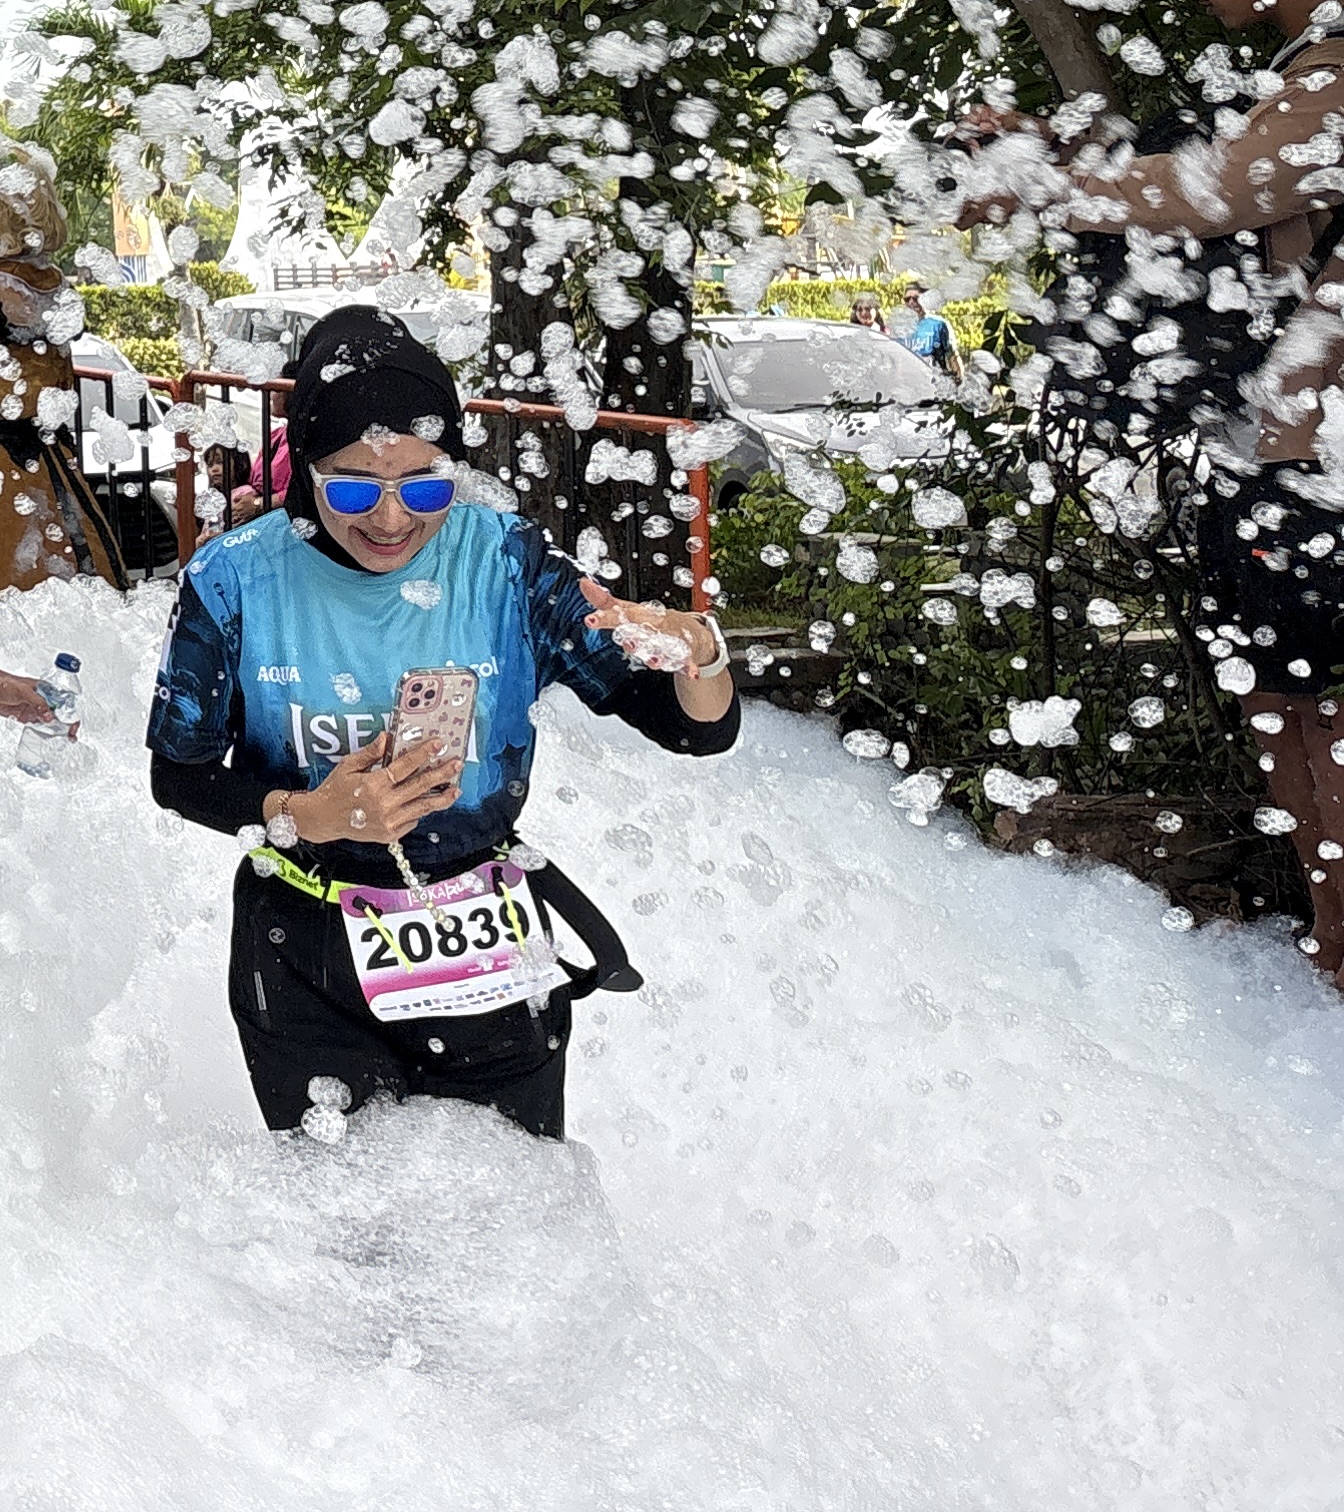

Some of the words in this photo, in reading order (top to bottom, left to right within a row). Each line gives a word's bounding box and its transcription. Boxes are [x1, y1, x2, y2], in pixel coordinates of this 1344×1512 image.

[256, 665, 301, 686] AQUA
[289, 869, 319, 891] Biznet
[360, 899, 530, 971] 20839
